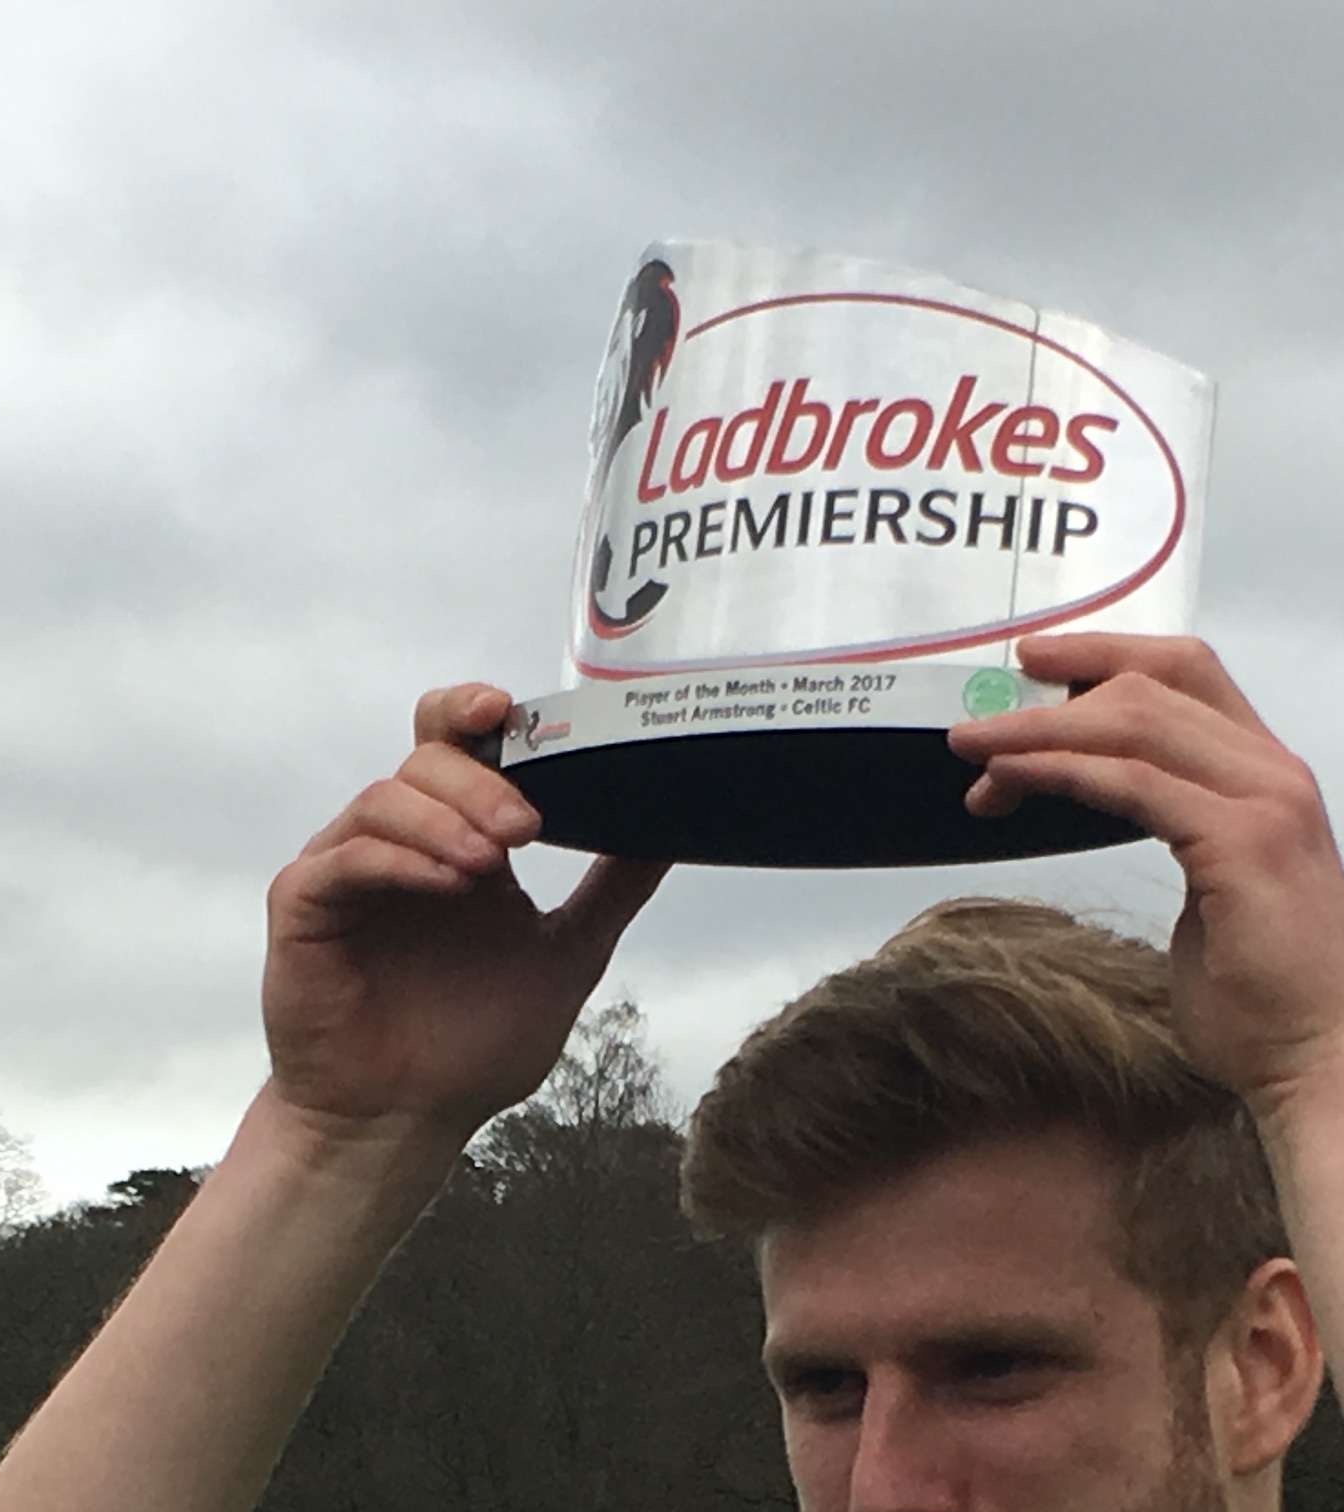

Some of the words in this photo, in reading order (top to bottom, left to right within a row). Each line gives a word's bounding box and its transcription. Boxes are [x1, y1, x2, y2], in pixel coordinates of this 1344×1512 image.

[636, 375, 1119, 504] Ladbrokes
[628, 487, 1099, 578] PREMIERSHIP
[624, 691, 670, 708] Player
[675, 684, 690, 701] of
[695, 683, 720, 700] the
[725, 680, 775, 697] Month
[792, 676, 844, 693] March
[850, 674, 896, 691] 2017
[641, 710, 686, 727] Stuart
[691, 704, 775, 722] Armstrong
[792, 698, 842, 715] Celtic
[848, 697, 871, 714] FC
